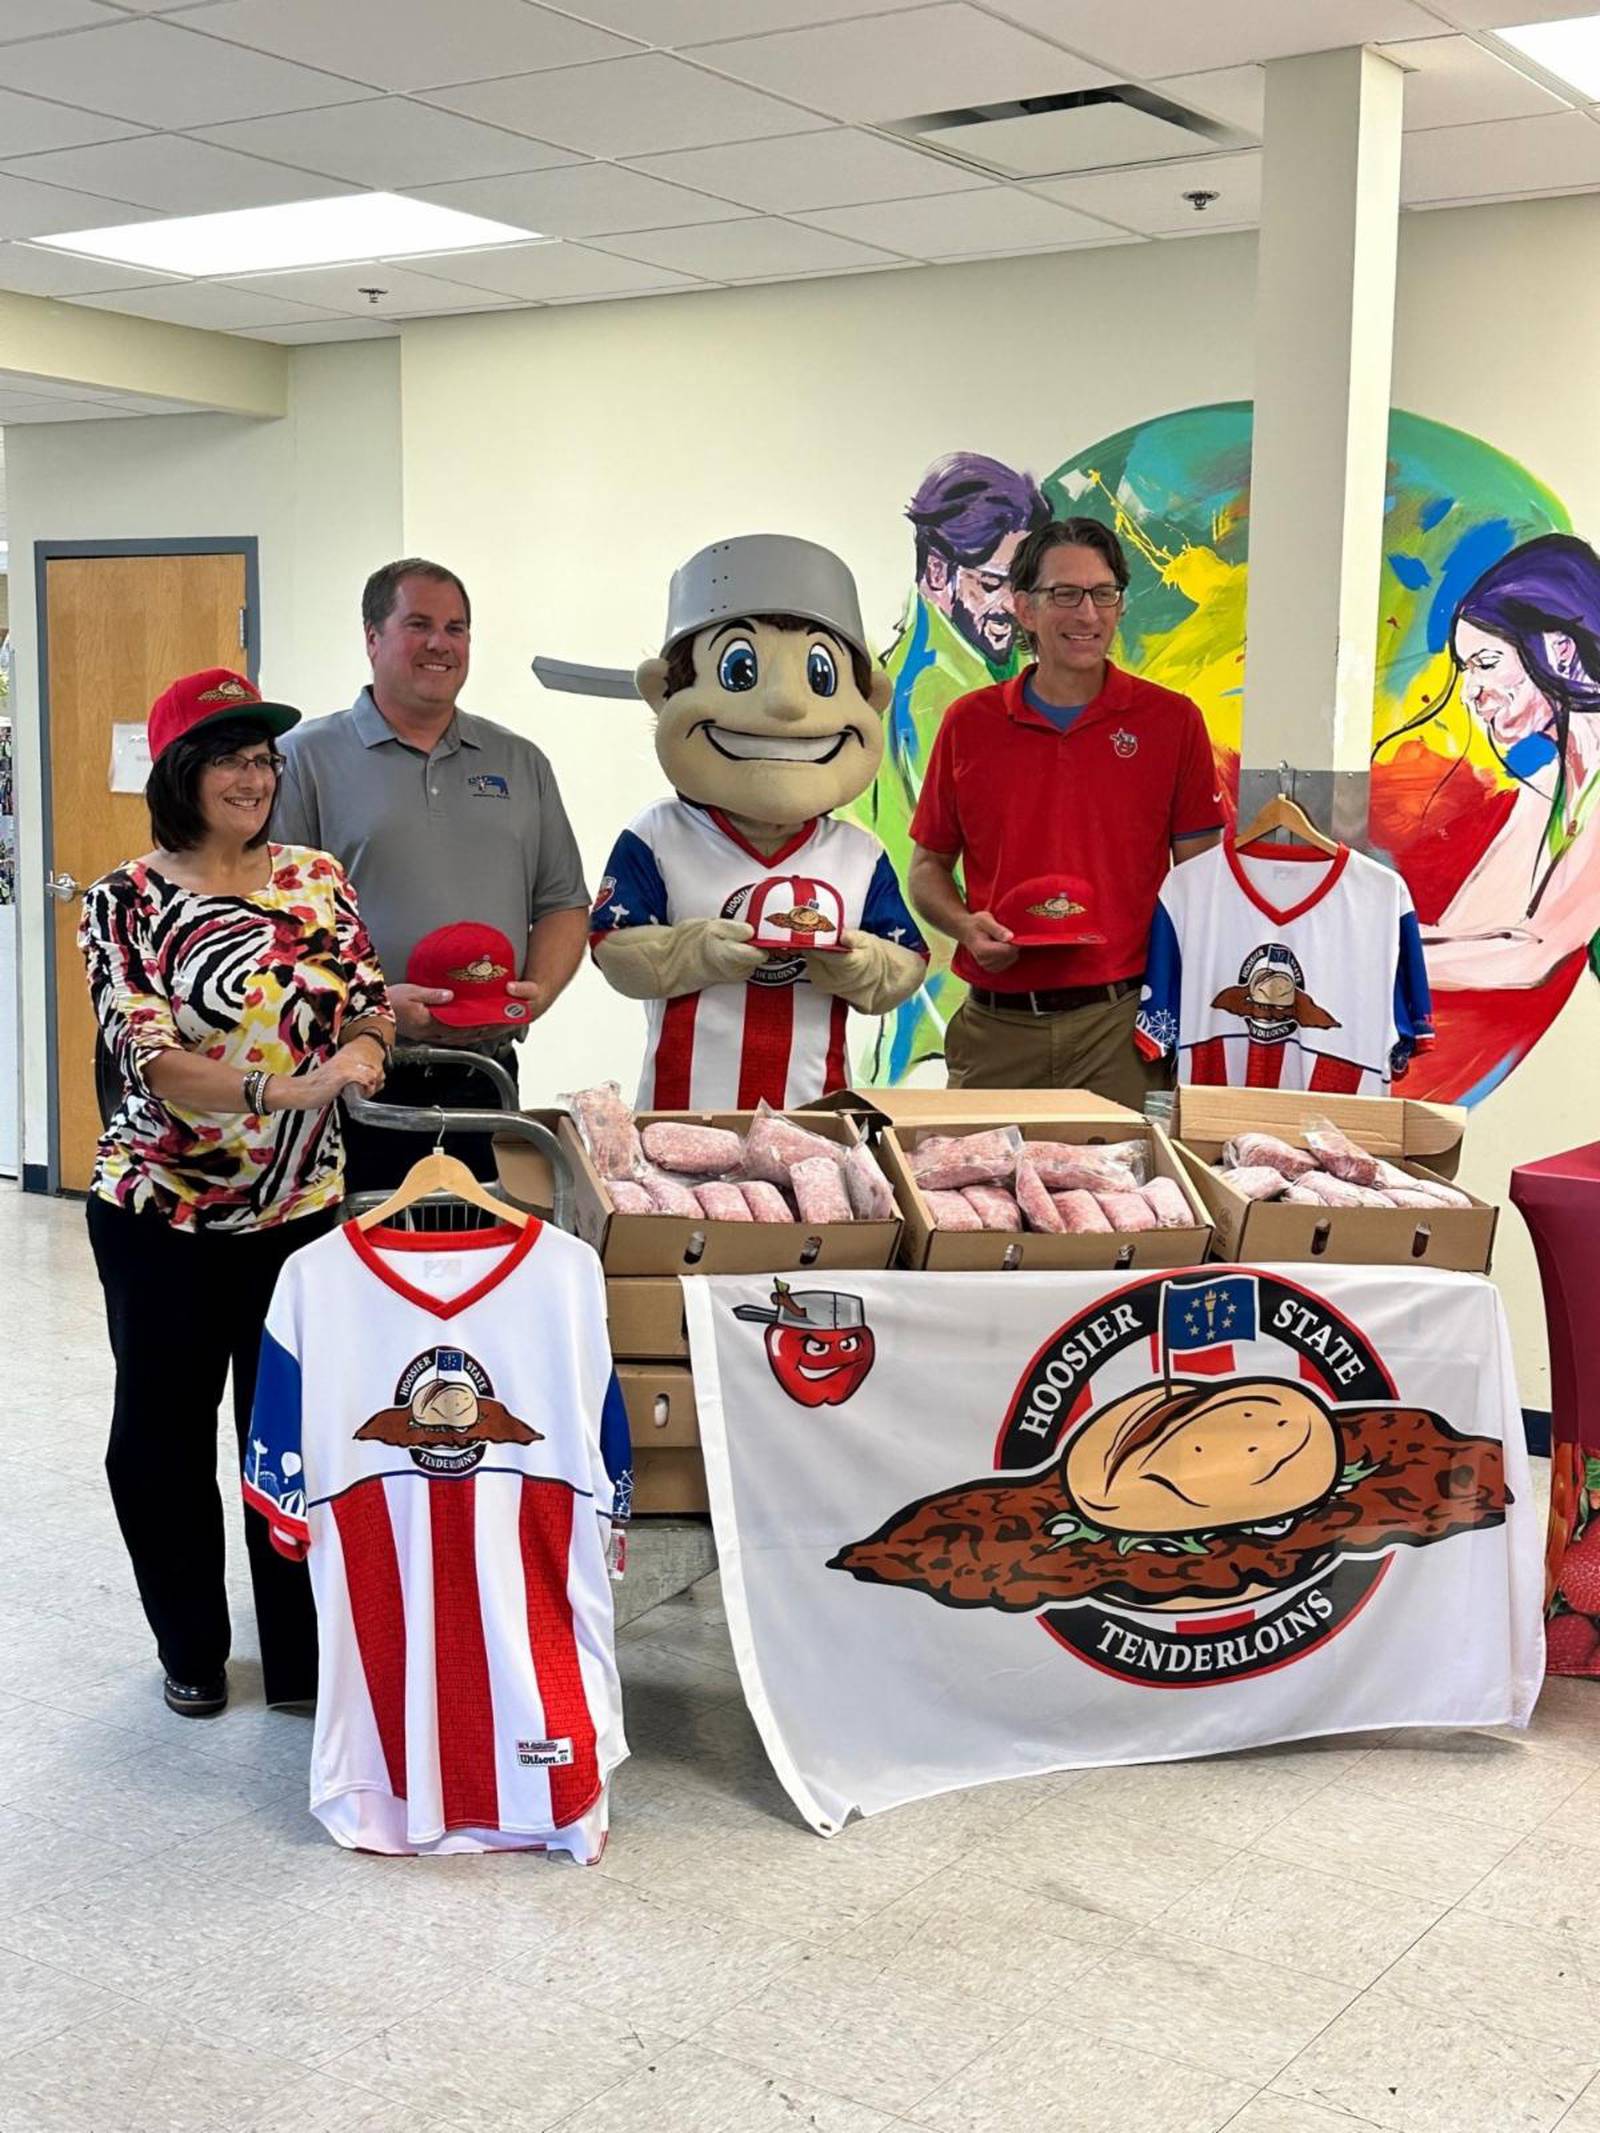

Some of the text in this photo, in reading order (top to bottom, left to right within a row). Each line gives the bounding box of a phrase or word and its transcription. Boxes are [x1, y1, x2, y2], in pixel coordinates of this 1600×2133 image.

[399, 1355, 489, 1397] HOOSIER STATE
[1020, 1299, 1366, 1439] HOOSIER STATE
[1096, 1588, 1334, 1673] TENDERLOINS
